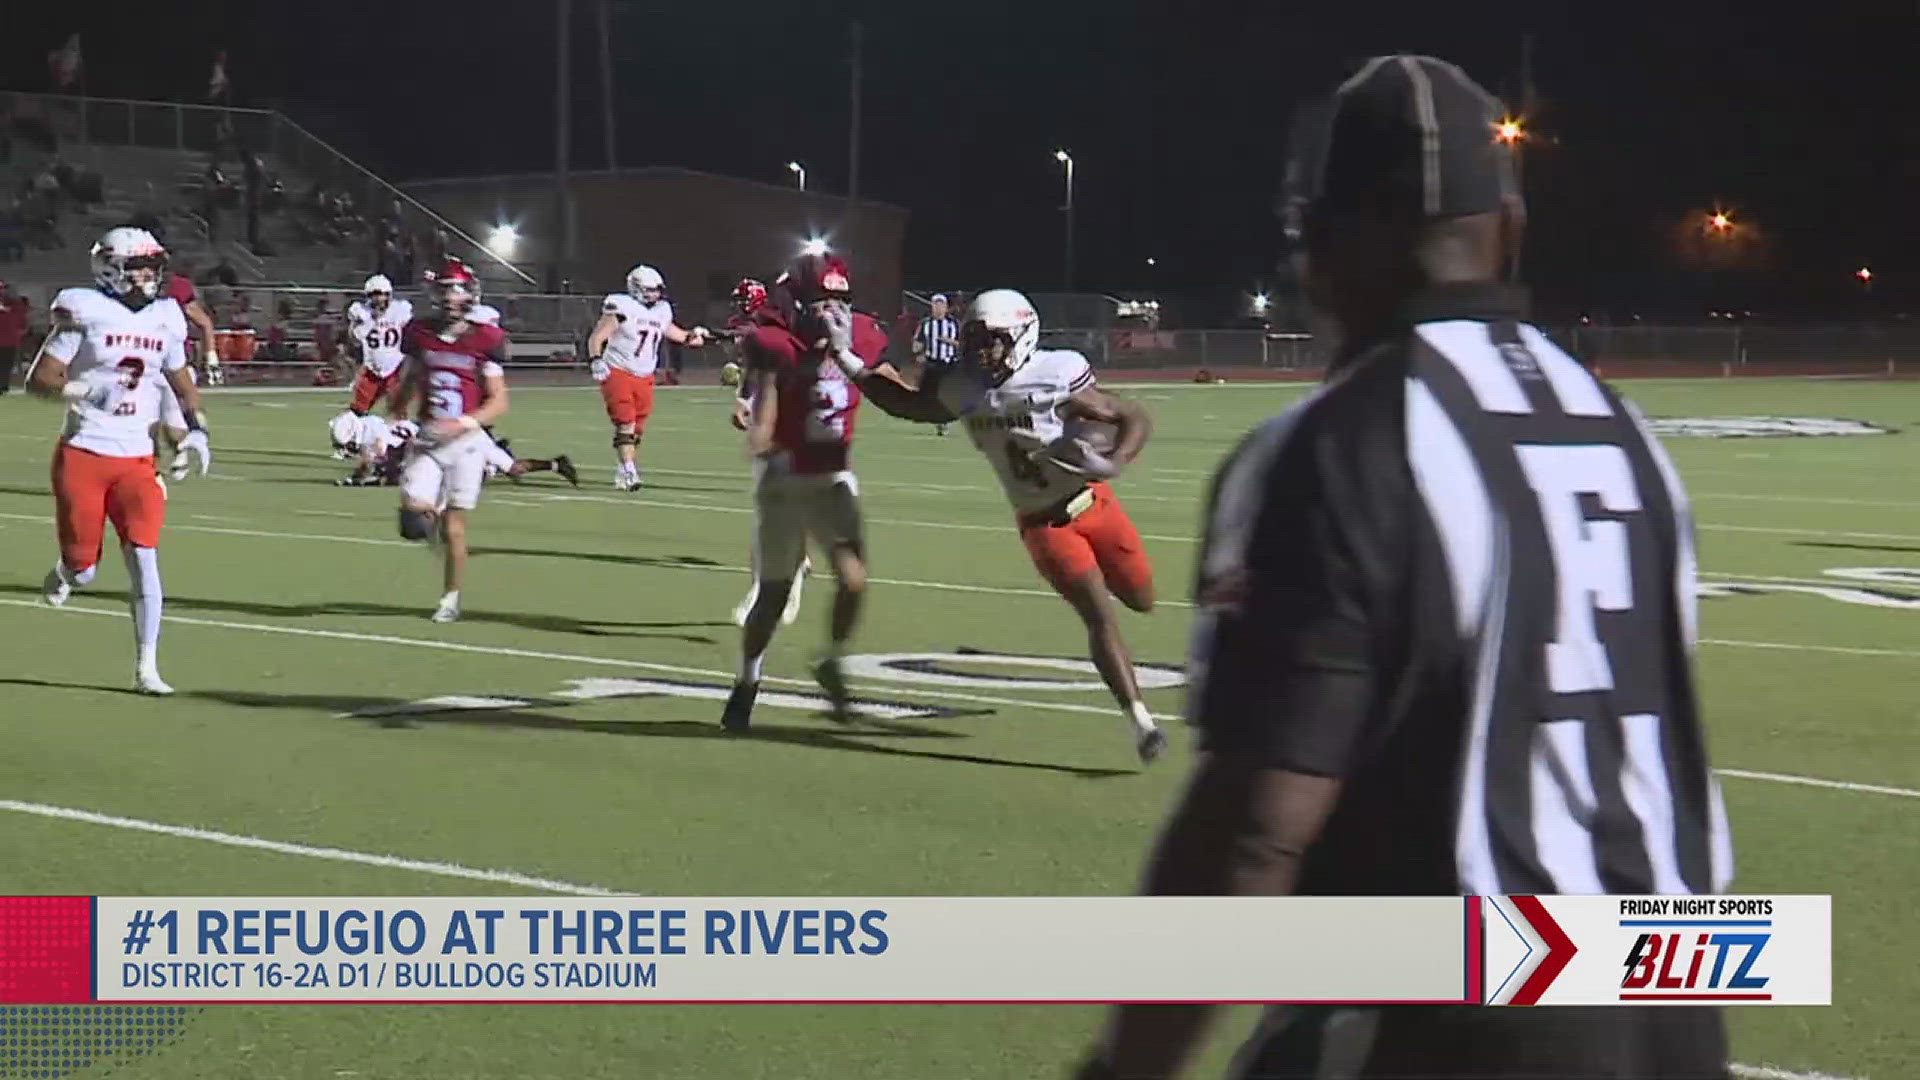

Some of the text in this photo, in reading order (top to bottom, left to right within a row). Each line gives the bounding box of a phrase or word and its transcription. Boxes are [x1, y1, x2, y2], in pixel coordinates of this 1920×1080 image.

[366, 328, 399, 349] 60
[634, 330, 658, 360] 71
[115, 356, 145, 391] 3
[1514, 443, 1641, 693] F
